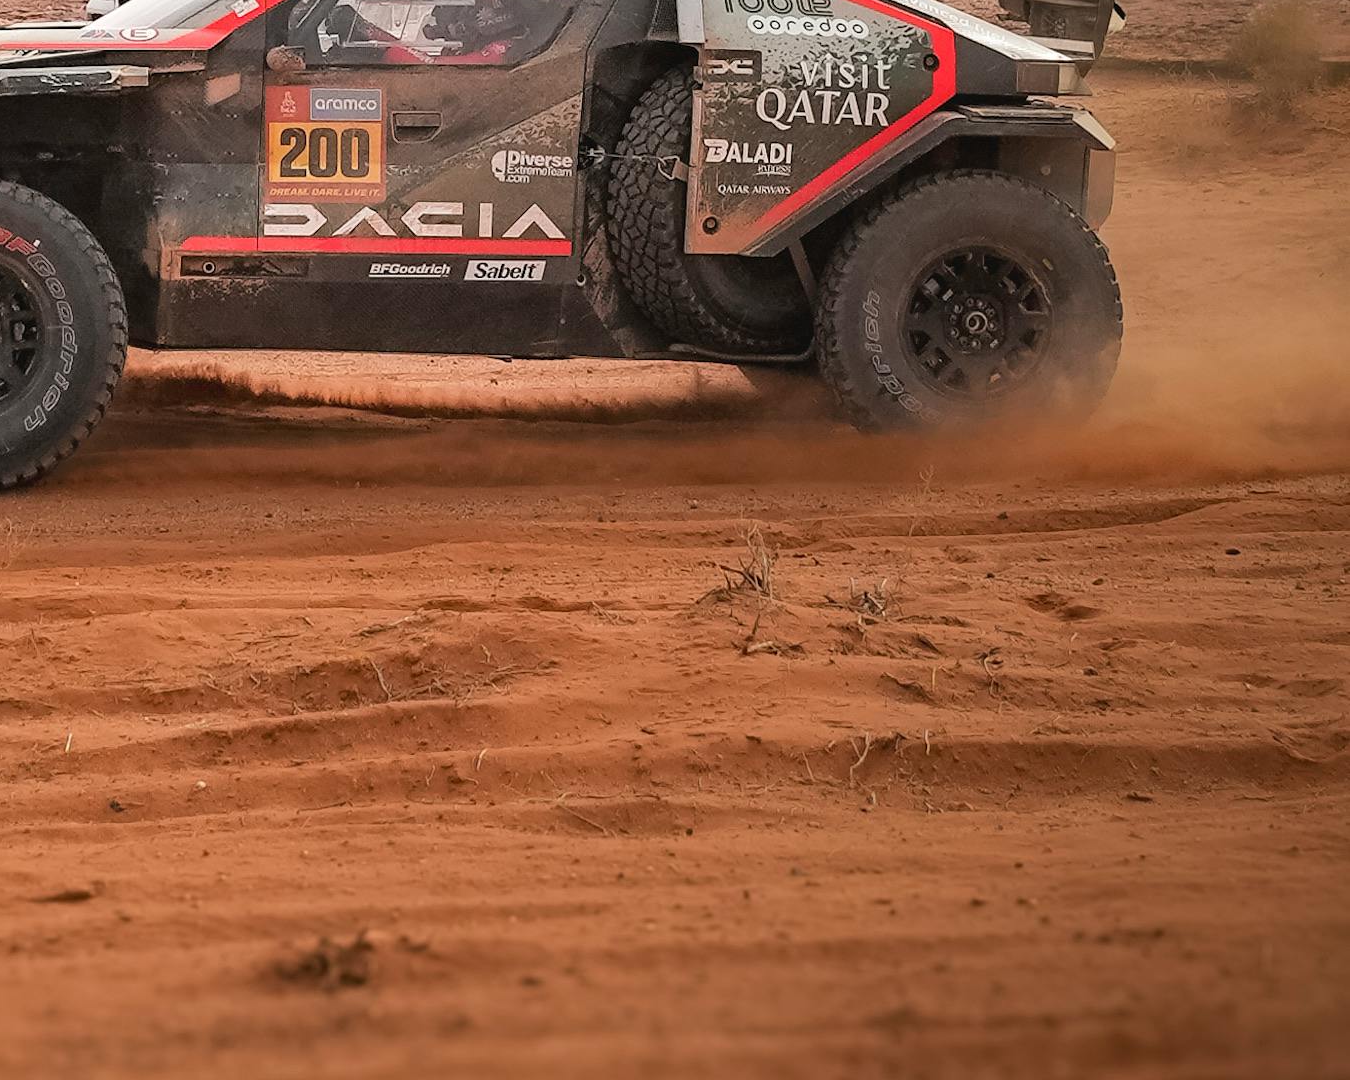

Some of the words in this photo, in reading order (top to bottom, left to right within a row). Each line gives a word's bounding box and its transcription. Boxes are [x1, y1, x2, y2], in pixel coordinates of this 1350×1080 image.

[751, 17, 865, 35] ooredoo
[800, 53, 893, 90] visit
[314, 98, 378, 111] aramco
[755, 88, 891, 131] QATAR
[280, 127, 370, 178] 200
[507, 150, 574, 168] Diverse
[703, 138, 793, 164] BALADI
[505, 175, 531, 183] .com
[269, 187, 309, 196] DREAM.
[311, 187, 342, 196] DARE.
[344, 188, 368, 196] LIVE
[717, 184, 750, 196] QATAR
[752, 185, 792, 195] AIRWAYS
[263, 201, 566, 238] DACIA
[368, 262, 452, 276] BFGoodrich
[473, 262, 537, 279] Sabelt
